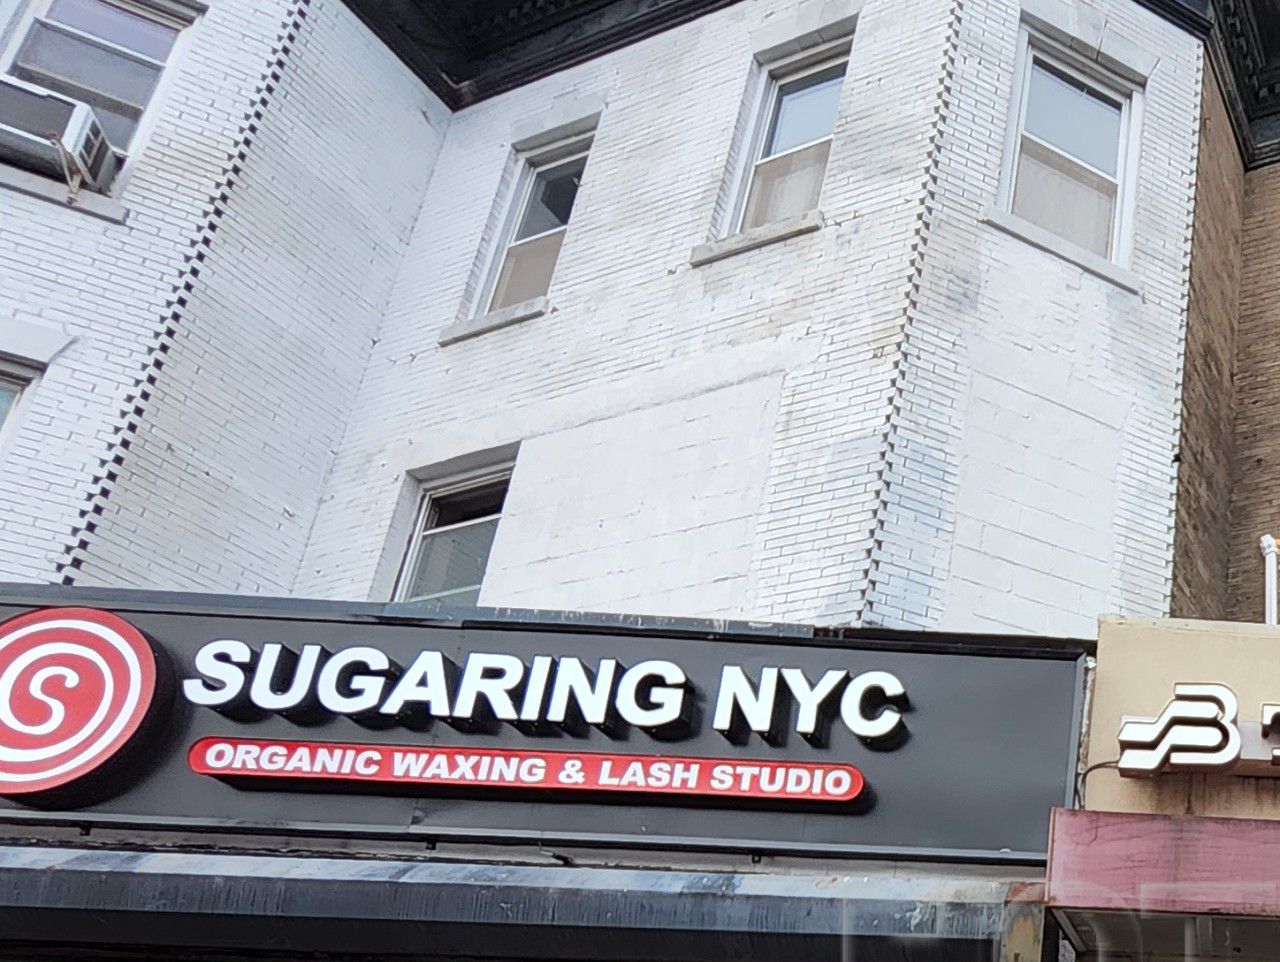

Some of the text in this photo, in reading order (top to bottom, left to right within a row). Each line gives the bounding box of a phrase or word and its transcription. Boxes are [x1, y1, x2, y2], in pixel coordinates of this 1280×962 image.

[183, 639, 905, 737] SUGARING NYC
[205, 742, 852, 795] ORGANIC WAXING & LASH STUDIO
